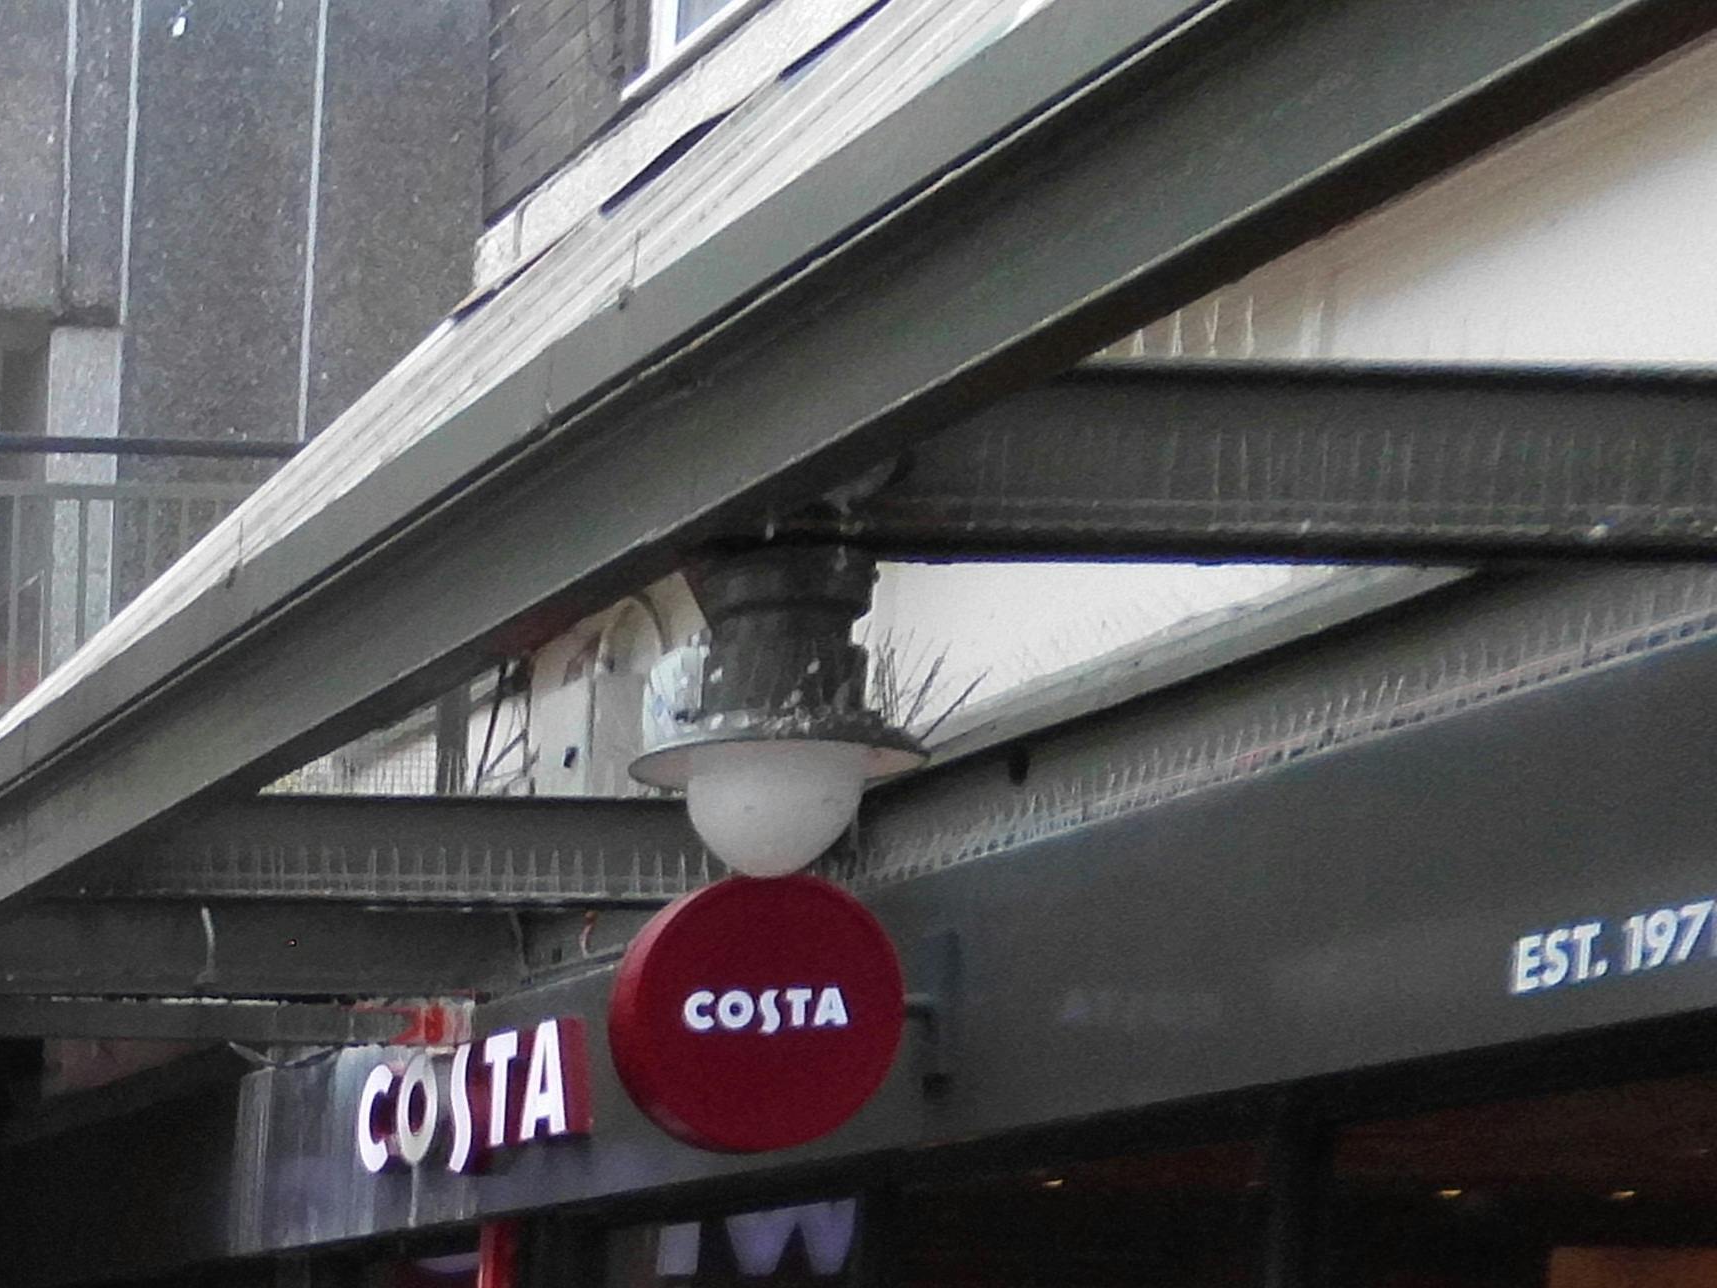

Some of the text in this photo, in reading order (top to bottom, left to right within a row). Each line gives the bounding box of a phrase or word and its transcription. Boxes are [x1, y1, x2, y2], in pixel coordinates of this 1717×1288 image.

[1511, 922, 1609, 994] EST.
[683, 985, 850, 1035] COSTA
[357, 1018, 568, 1174] COSTA
